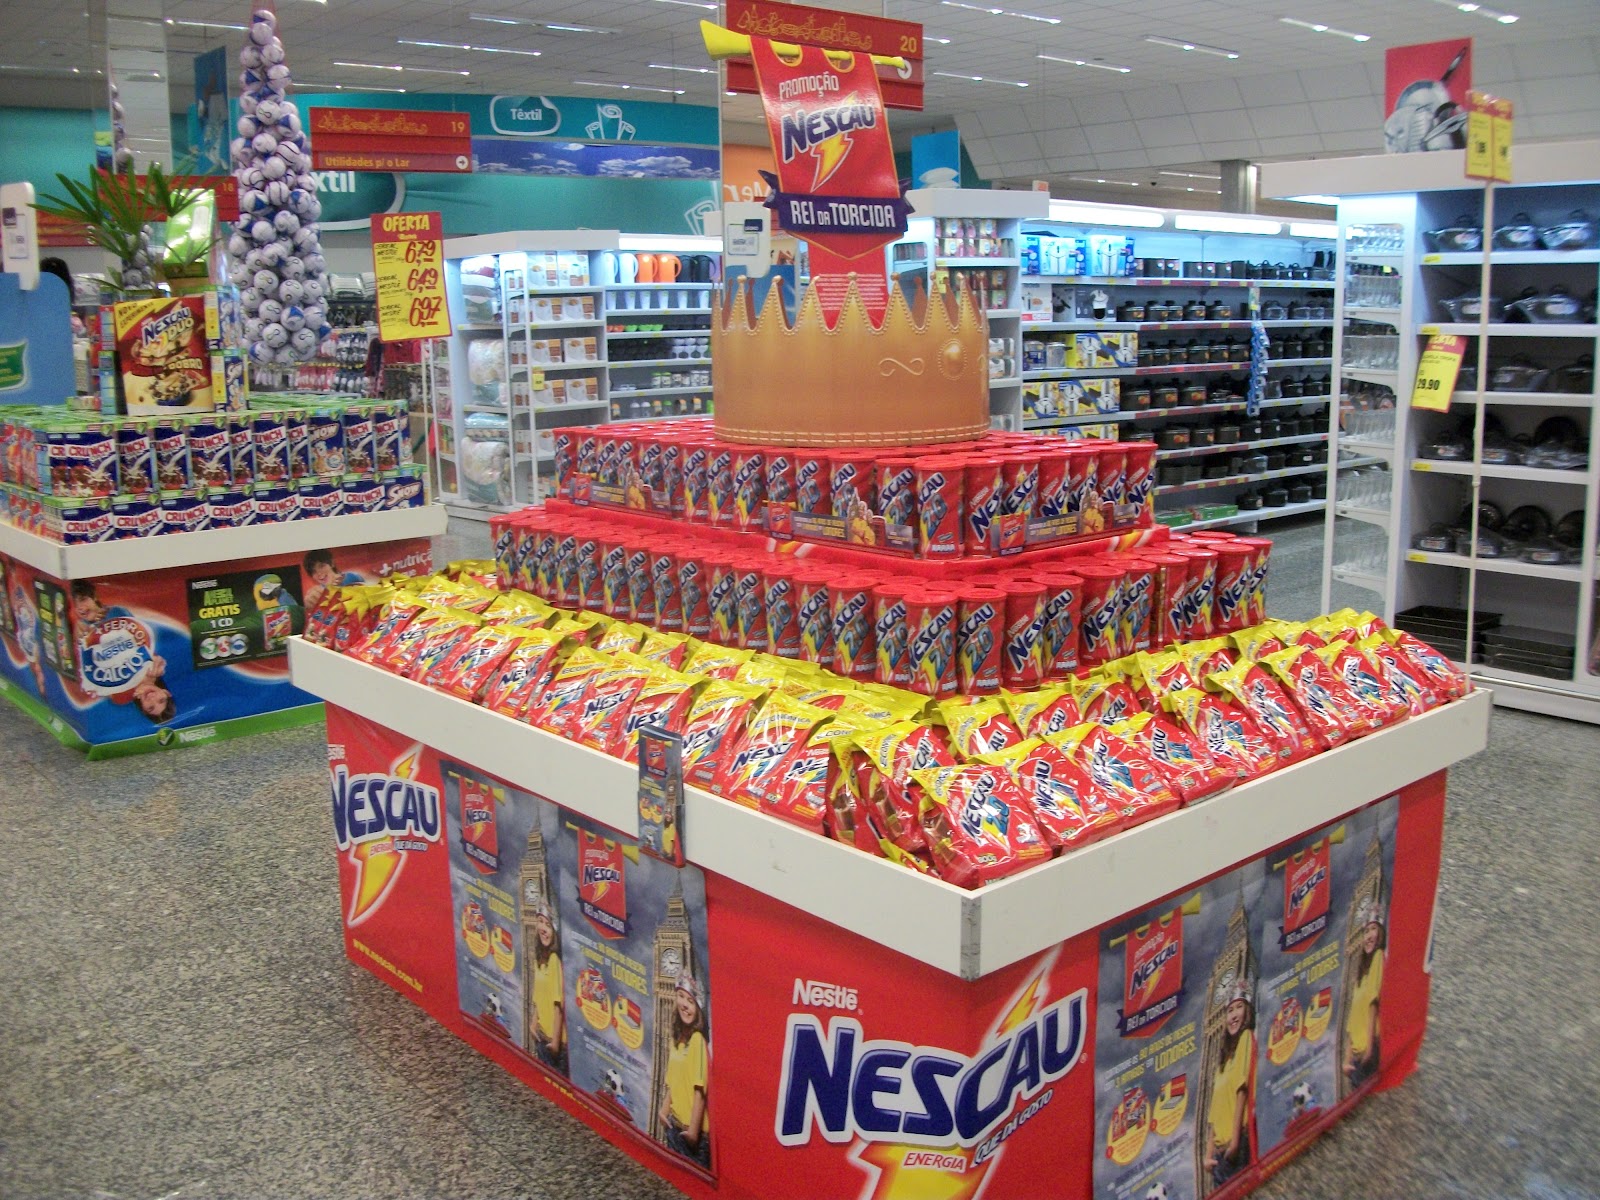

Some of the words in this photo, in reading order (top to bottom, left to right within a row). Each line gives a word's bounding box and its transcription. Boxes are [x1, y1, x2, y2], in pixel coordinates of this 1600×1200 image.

[900, 36, 917, 53] 20
[779, 71, 840, 100] PROMOÇÃO
[510, 108, 542, 121] Têxtil
[452, 122, 465, 133] 19
[781, 104, 876, 164] NESCAU
[325, 156, 373, 167] Utilidades
[387, 159, 393, 167] o
[395, 158, 410, 167] Lar
[222, 182, 234, 192] 18
[790, 200, 815, 225] REI
[817, 211, 830, 225] DA
[828, 202, 896, 227] TORCIDA
[382, 214, 430, 232] OFERTA
[142, 307, 192, 349] NESCAU
[167, 318, 194, 340] DUO
[303, 492, 338, 507] CRUNCH
[346, 488, 382, 502] CRUNCH
[165, 506, 206, 521] CRUNCH
[213, 501, 251, 517] CRUNCH
[260, 498, 296, 512] CRUNCH
[66, 517, 109, 533] CRUNCH
[117, 511, 158, 527] CRUNCH
[104, 620, 145, 641] FERRO
[210, 620, 216, 628] 1
[218, 618, 233, 627] CD
[96, 639, 134, 662] Nestlé
[583, 864, 621, 886] NESCAU
[1128, 940, 1178, 1000] NESCAU
[792, 978, 858, 1011] Nestlé
[777, 990, 1086, 1146] NESCAU
[903, 1153, 965, 1170] ENERGIA
[974, 1130, 1002, 1164] QUE
[1019, 1088, 1053, 1125] GOSTO
